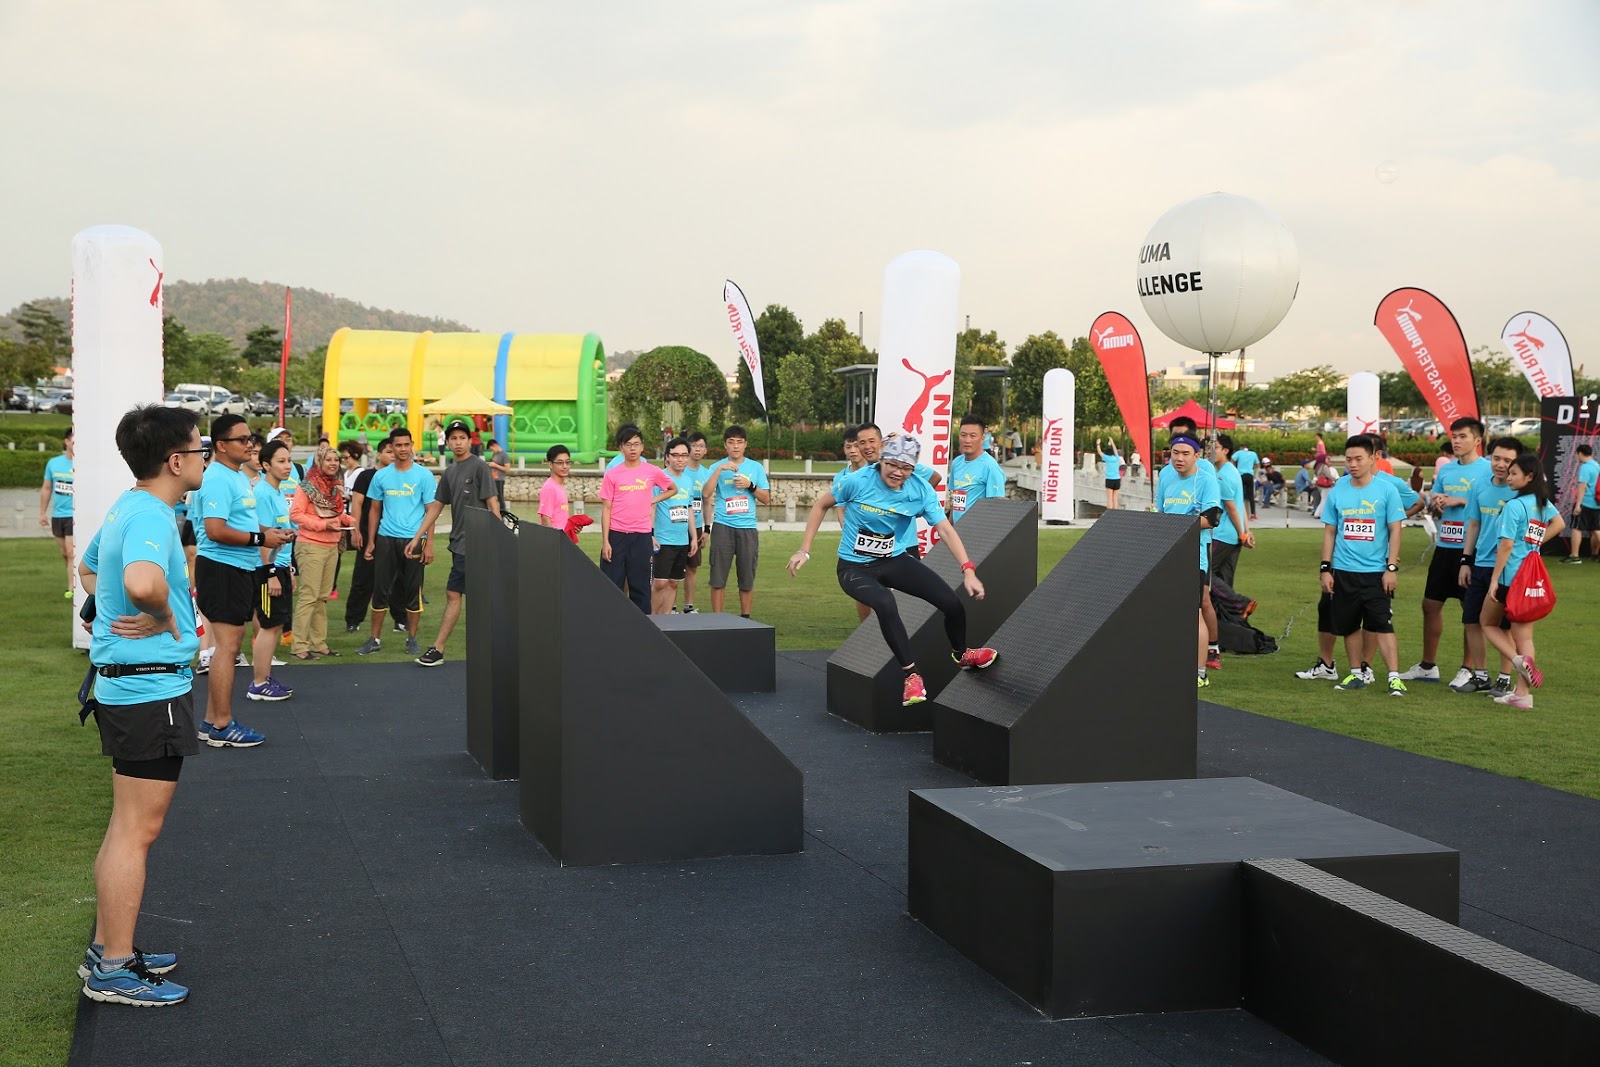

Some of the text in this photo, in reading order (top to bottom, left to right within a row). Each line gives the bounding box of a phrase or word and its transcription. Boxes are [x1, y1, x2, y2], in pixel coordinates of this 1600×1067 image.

[1139, 242, 1171, 264] UMA
[1137, 271, 1203, 297] LLENGE
[933, 394, 951, 466] RUN
[1046, 427, 1063, 503] NIGHT RUN
[726, 501, 748, 509] A1605
[1344, 524, 1374, 533] A1321
[857, 537, 894, 550] B7759
[917, 529, 928, 558] MA
[1524, 587, 1546, 598] PUMA
